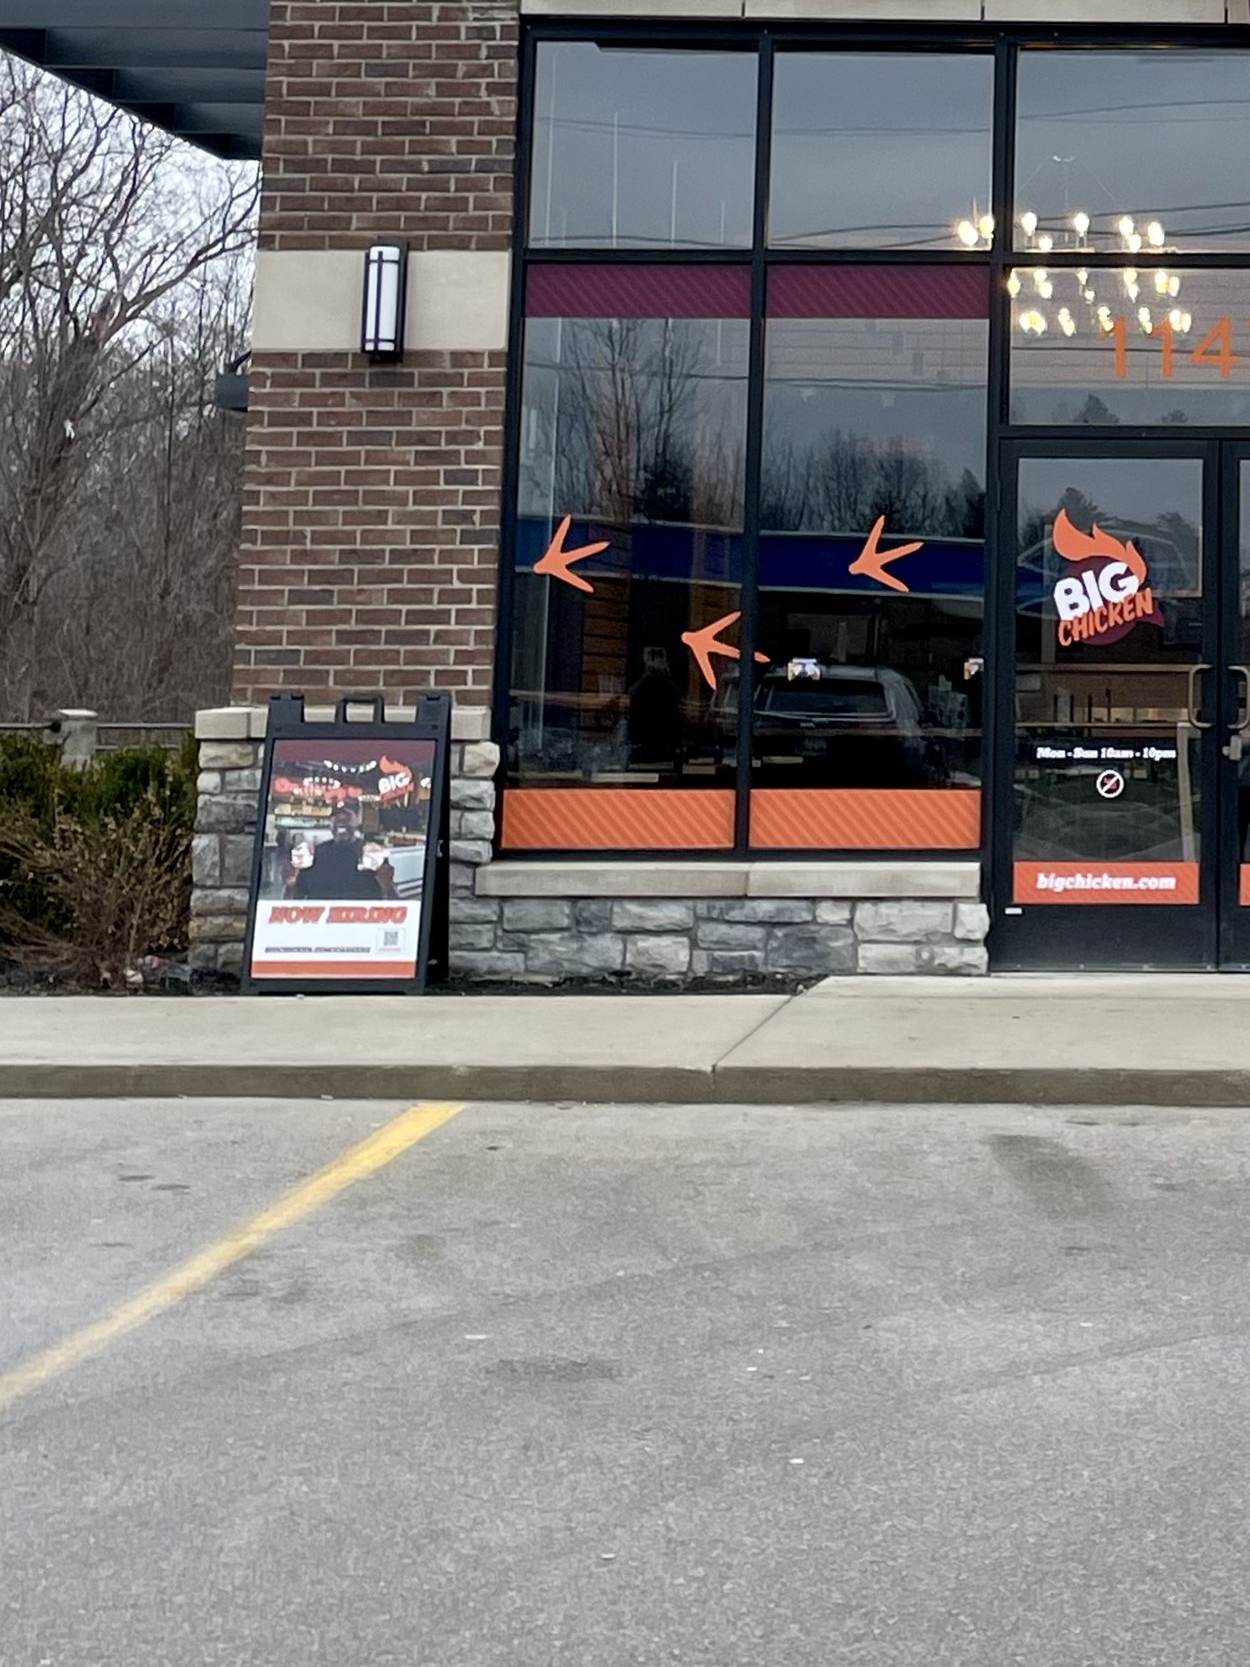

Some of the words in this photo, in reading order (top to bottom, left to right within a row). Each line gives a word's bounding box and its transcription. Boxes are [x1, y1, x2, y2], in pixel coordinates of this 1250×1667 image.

[1054, 562, 1140, 621] BIG
[1058, 587, 1153, 646] CHICKEN
[1036, 747, 1066, 759] Mon
[1073, 747, 1098, 759] Sun
[1100, 747, 1134, 759] 10am
[1143, 747, 1176, 761] 10pm
[378, 772, 410, 793] BIG
[1037, 872, 1177, 893] bigchicken.com
[269, 906, 326, 924] NOW
[326, 906, 408, 924] HIRING
